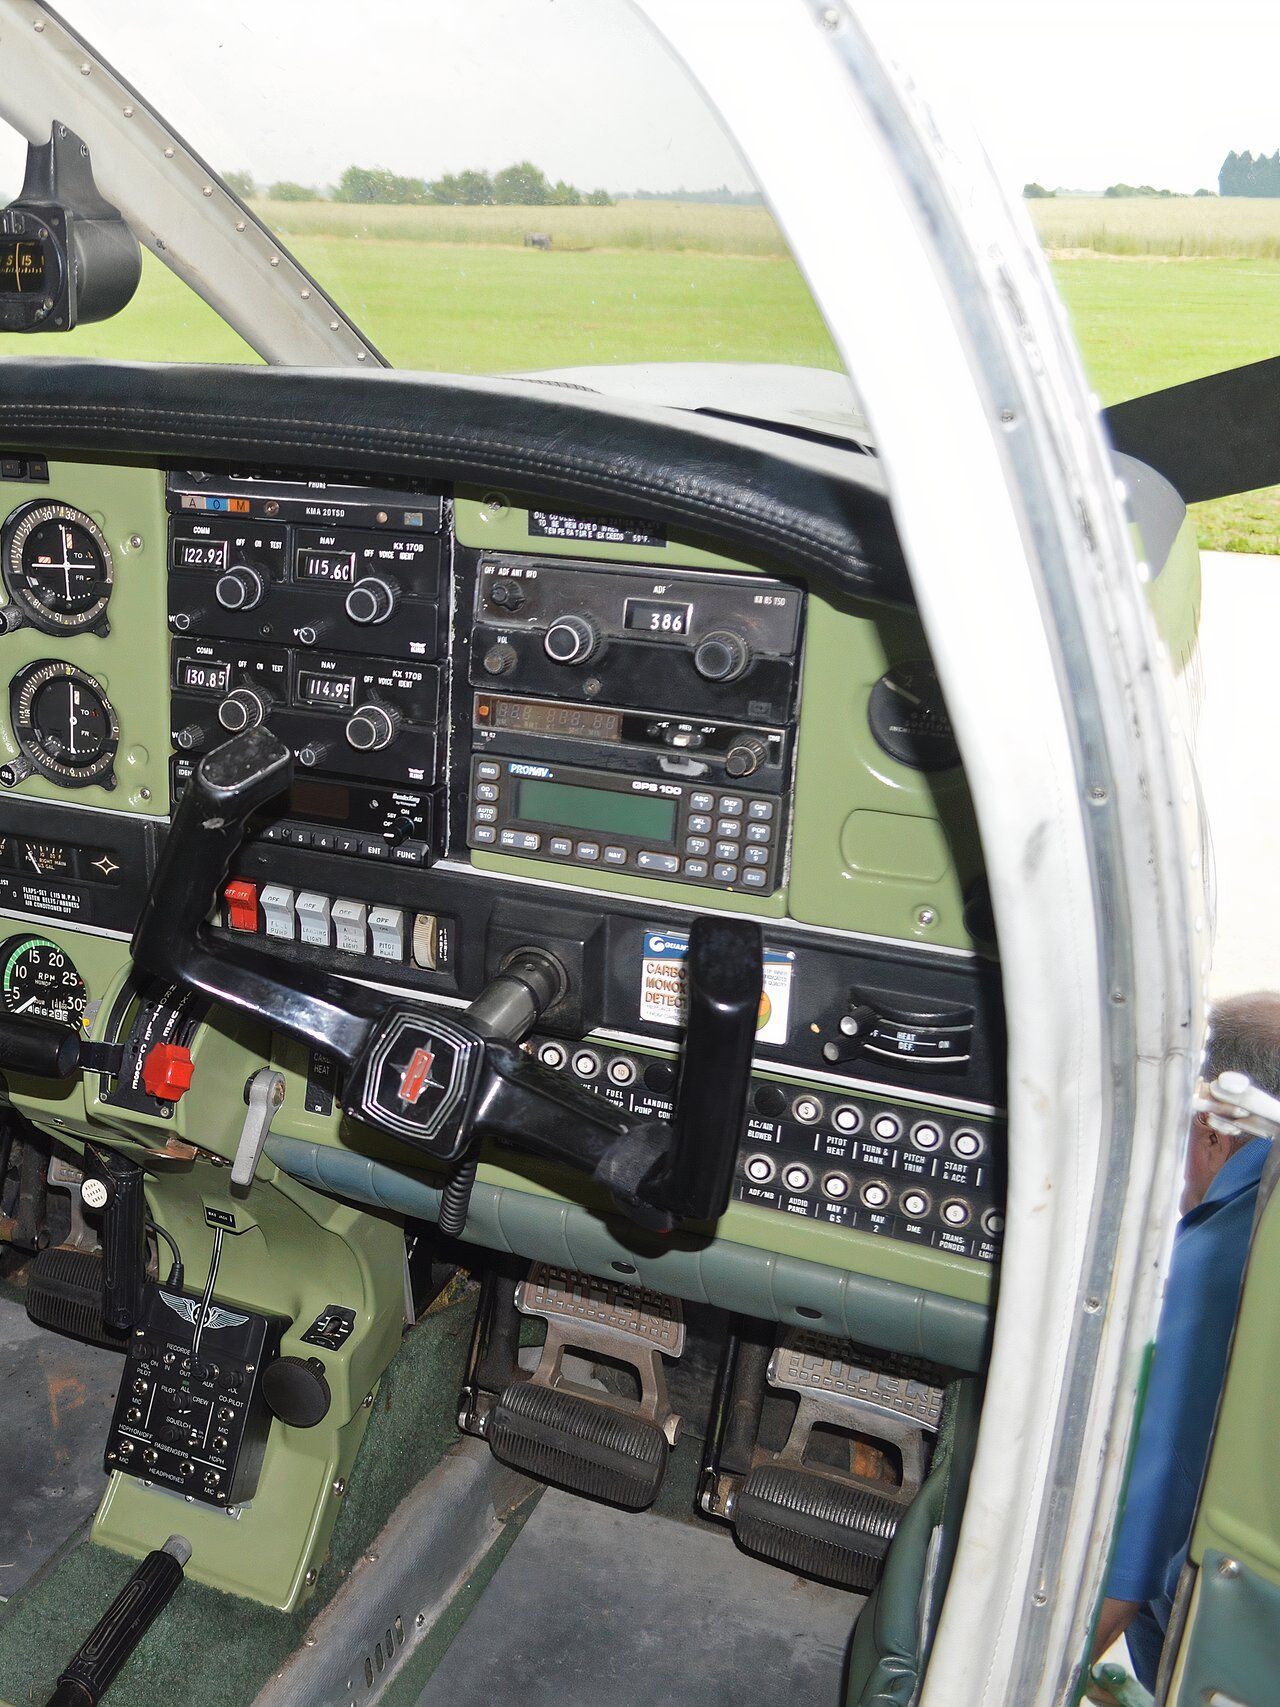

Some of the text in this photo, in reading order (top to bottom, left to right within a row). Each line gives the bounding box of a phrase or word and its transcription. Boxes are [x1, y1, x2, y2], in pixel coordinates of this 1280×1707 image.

[21, 255, 32, 266] 15
[189, 498, 197, 508] A
[213, 500, 221, 510] O
[237, 502, 245, 511] M
[65, 511, 76, 520] 33
[305, 507, 322, 516] KMA
[193, 526, 211, 535] COMM
[544, 527, 593, 539] TEMPERATURE
[270, 541, 283, 550] TEST
[320, 537, 335, 546] NAV
[393, 542, 424, 553] KX 170B
[184, 548, 223, 565] 122.92
[379, 550, 394, 559] VOICE
[399, 551, 414, 561] IDENT
[484, 566, 523, 578] OFF ADF ANT
[653, 585, 666, 595] ADF
[650, 613, 682, 631] 386
[497, 635, 509, 644] VOL
[196, 646, 213, 655] COMM
[238, 660, 247, 668] OFF
[271, 664, 284, 673] TEST
[321, 661, 336, 670] NAV
[187, 669, 225, 688] 130.85
[363, 675, 374, 683] OFF
[392, 670, 422, 681] KX 170B
[378, 677, 393, 686] VOICE
[398, 680, 413, 689] IDENT
[510, 764, 549, 777] PRONAV
[632, 781, 682, 796] GPS 100
[367, 846, 381, 855] ENT
[396, 851, 416, 860] FUNC
[29, 949, 40, 964] 15
[48, 952, 64, 968] 20
[15, 964, 27, 979] 10
[646, 963, 686, 979] CARBO
[38, 972, 56, 981] RPM
[62, 971, 78, 987] 25
[646, 976, 688, 994] MONOX
[12, 986, 20, 1000] 5
[67, 996, 83, 1011] 30
[645, 992, 687, 1009] DETECT
[162, 991, 192, 1037] IXTURE
[132, 984, 177, 1090] HROTTLE CLOSE
[897, 1032, 916, 1042] HEAT
[897, 1042, 915, 1052] DEF.
[938, 1040, 950, 1049] ON
[313, 1065, 330, 1075] HEAT
[606, 1088, 624, 1099] FUEL
[643, 1097, 674, 1111] LANDING
[634, 1106, 653, 1115] PUMP
[747, 1129, 773, 1142] BLOWER
[826, 1136, 847, 1147] PITOT
[826, 1146, 845, 1157] HEAT
[862, 1144, 881, 1154] TURN
[864, 1154, 884, 1165] BANK
[903, 1153, 925, 1164] PITCH
[904, 1162, 923, 1173] TRIM
[944, 1161, 968, 1174] START
[748, 1188, 775, 1200] ADF/MB
[788, 1197, 809, 1208] AUDIO
[787, 1205, 808, 1216] PANEL
[826, 1203, 842, 1214] NAV
[870, 1214, 885, 1225] NAV
[873, 1224, 879, 1233] 2
[906, 1224, 922, 1234] DME
[941, 1232, 965, 1244] TRANS-
[939, 1241, 965, 1253] PONDER
[166, 1342, 191, 1356] RECORDE
[140, 1362, 151, 1370] VOL
[136, 1367, 152, 1377] PILOT
[179, 1370, 191, 1378] OUT
[160, 1384, 176, 1394] PILOT
[180, 1385, 191, 1394] ALL
[202, 1380, 214, 1389] AUX
[131, 1397, 142, 1405] MIC
[192, 1396, 210, 1406] CREW
[165, 1415, 192, 1430] SQUELCH
[217, 1426, 229, 1435] MIC
[154, 1441, 189, 1459] PASSENGERS
[119, 1455, 129, 1464] MIC
[208, 1455, 225, 1465] HDPH
[148, 1467, 185, 1485] HEADPHONES
[203, 1486, 215, 1496] MIC
